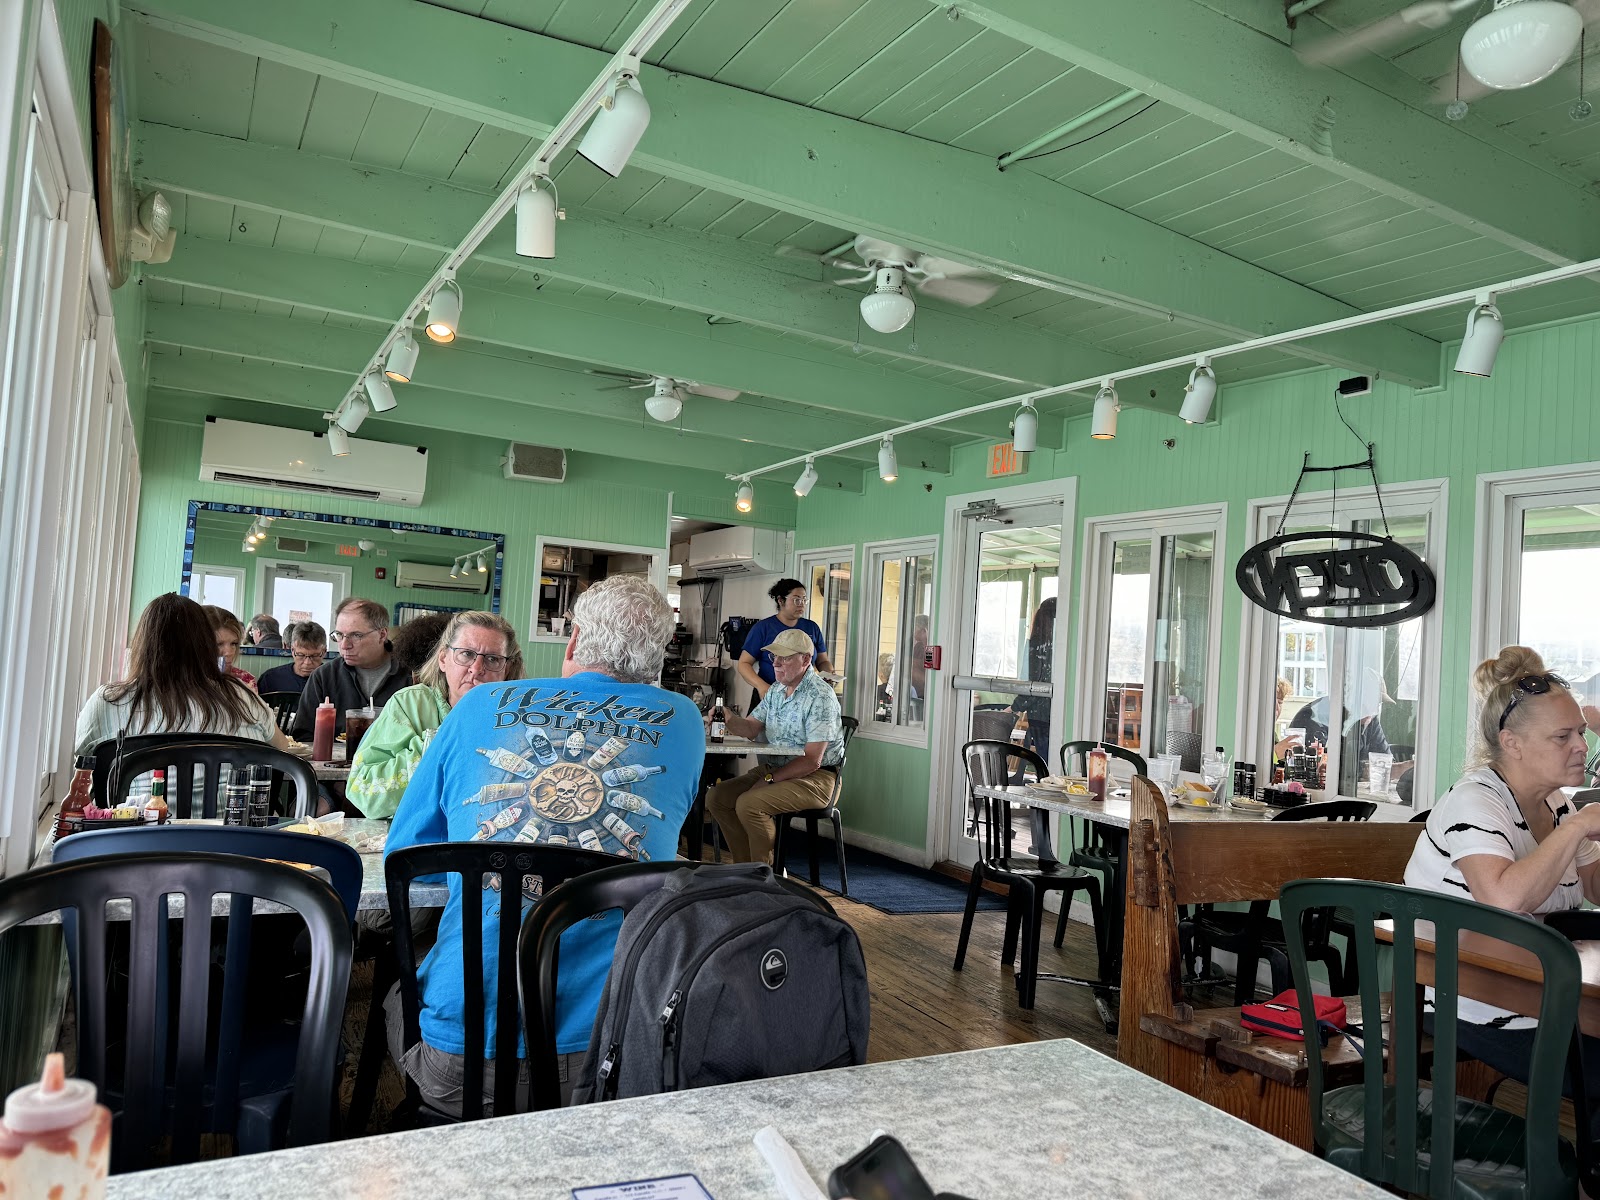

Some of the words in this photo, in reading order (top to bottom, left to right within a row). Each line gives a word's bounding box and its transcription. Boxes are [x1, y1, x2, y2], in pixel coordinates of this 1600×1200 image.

[992, 443, 1018, 474] EXIT
[490, 686, 676, 726] Wicked
[493, 711, 664, 748] DOLPHIN
